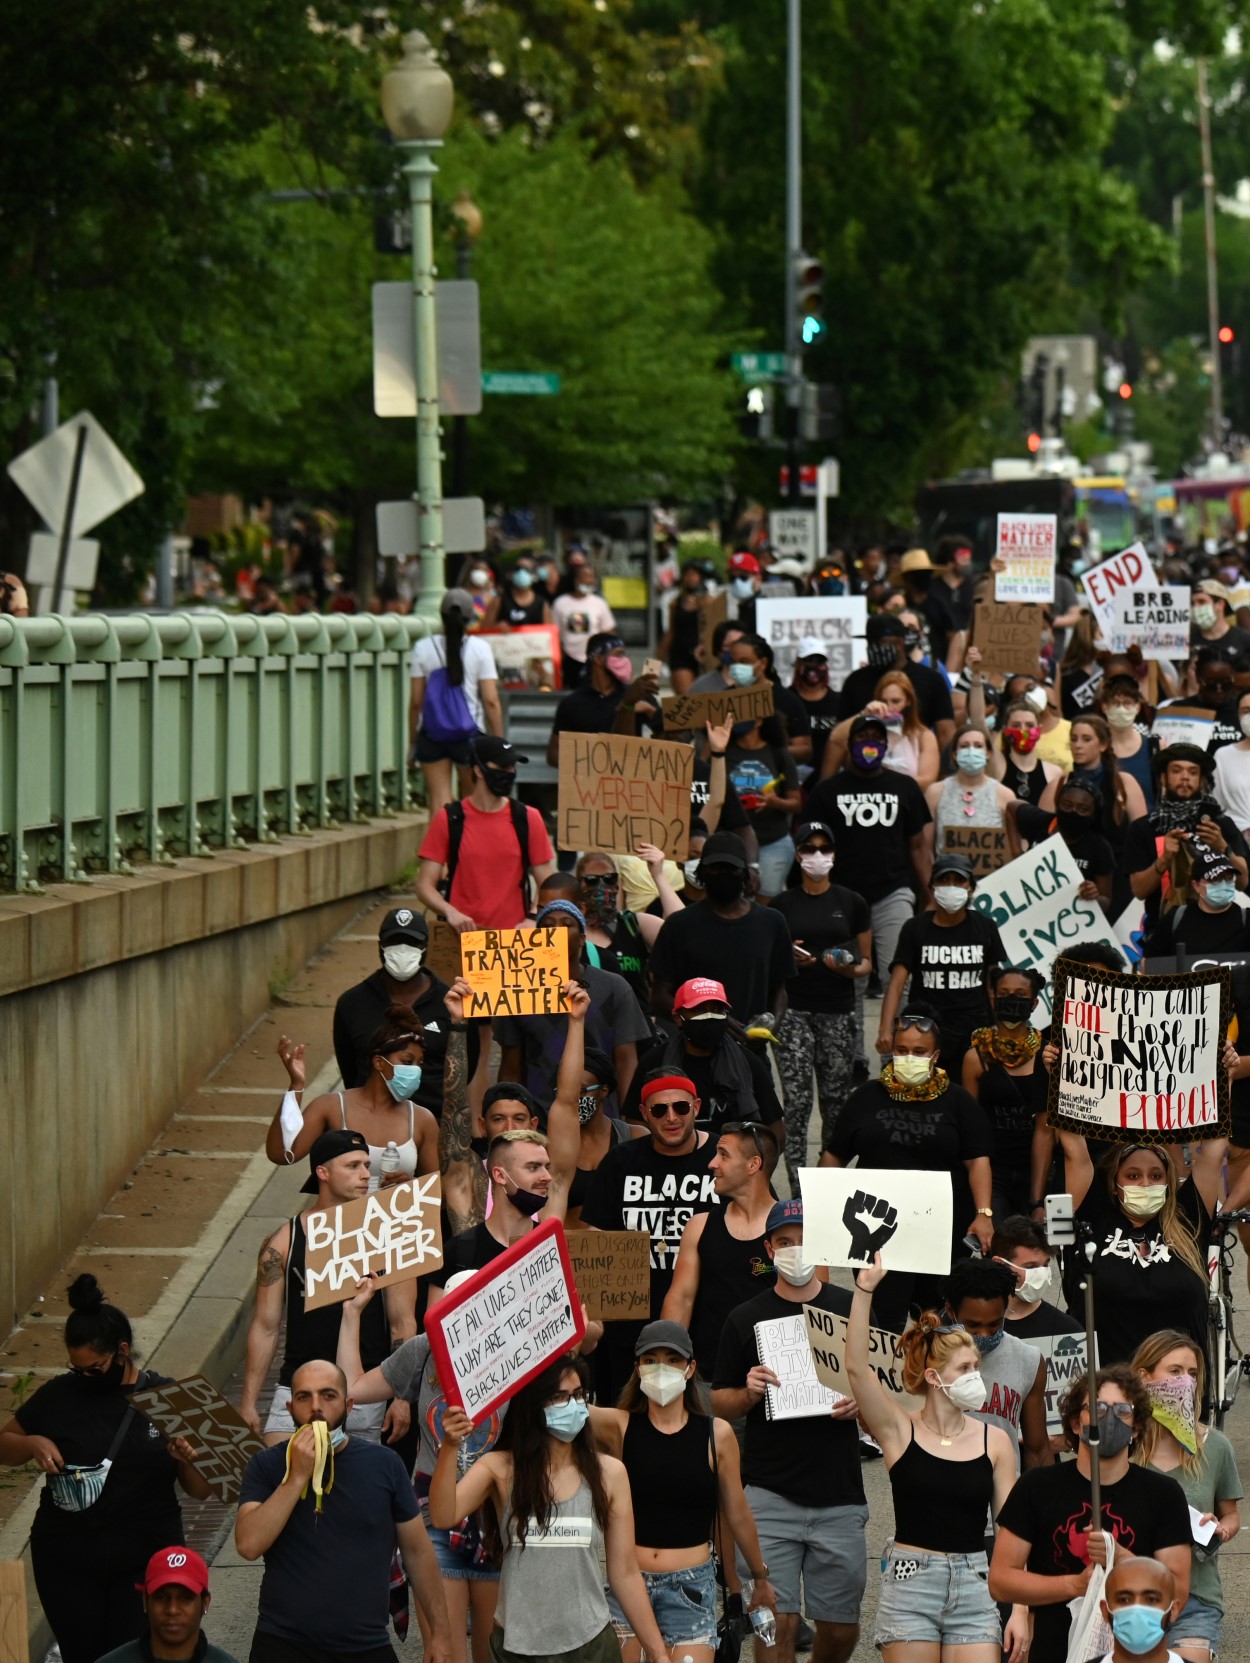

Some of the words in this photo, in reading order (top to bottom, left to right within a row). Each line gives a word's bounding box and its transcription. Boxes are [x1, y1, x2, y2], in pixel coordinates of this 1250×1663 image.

[777, 517, 808, 532] ONE
[1000, 532, 1054, 545] MATTER
[776, 534, 809, 546] WAY
[1087, 552, 1143, 606] END
[1133, 592, 1174, 607] BRB
[981, 605, 1040, 625] BLACK
[1123, 609, 1190, 624] LEADING
[771, 618, 852, 642] BLACK
[987, 625, 1033, 645] LIVES
[707, 690, 774, 722] MATTER
[574, 740, 628, 777] HOW
[634, 746, 694, 786] MANY
[573, 775, 690, 820] WEREN'T
[837, 793, 884, 805] BELIEVE
[884, 792, 899, 804] IN
[837, 803, 899, 827] YOU
[566, 808, 685, 855] FILMED?
[944, 830, 1006, 850] BLACK
[972, 850, 1071, 929] BLACK
[485, 928, 557, 950] BLACK
[999, 896, 1096, 970] Lives
[464, 948, 535, 972] TRANS
[501, 967, 563, 989] LIVES
[922, 970, 945, 990] WE
[948, 970, 983, 989] BALL
[471, 985, 569, 1016] MATTER
[1081, 980, 1154, 1018] system
[1118, 1013, 1185, 1047] those
[1062, 1027, 1104, 1061] was
[1111, 1038, 1196, 1074] Never
[1061, 1053, 1148, 1100] designed
[1154, 1071, 1177, 1096] to
[875, 1107, 921, 1121] GIVE
[925, 1112, 944, 1123] IT
[881, 1119, 937, 1136] YOUR
[623, 1173, 721, 1204] BLACK
[307, 1174, 442, 1252] BLACK
[623, 1208, 692, 1239] LIVES
[332, 1216, 423, 1265] LIVES
[306, 1228, 442, 1297] MATTER
[571, 1256, 616, 1273] TRUMP.
[618, 1256, 648, 1269] SUCK
[616, 1275, 633, 1287] ON
[636, 1274, 646, 1287] IT
[446, 1318, 461, 1349] IF
[484, 1281, 516, 1318] LIVES
[519, 1247, 560, 1292] MATTER
[600, 1290, 627, 1311] FUCK
[453, 1343, 482, 1379] WHY
[484, 1327, 507, 1355] ARE
[503, 1302, 533, 1336] THEY
[535, 1278, 565, 1316] GONE?
[764, 1318, 807, 1353] BLA
[808, 1309, 834, 1337] NO
[501, 1341, 532, 1383] LIVES
[532, 1304, 573, 1352] MATTER!
[770, 1348, 816, 1382] LIV
[813, 1347, 840, 1373] NO
[180, 1378, 267, 1458] BLAC
[133, 1392, 241, 1502] MATTER
[524, 1525, 552, 1537] alvin
[554, 1525, 580, 1537] Klein
[167, 1553, 187, 1568] W
